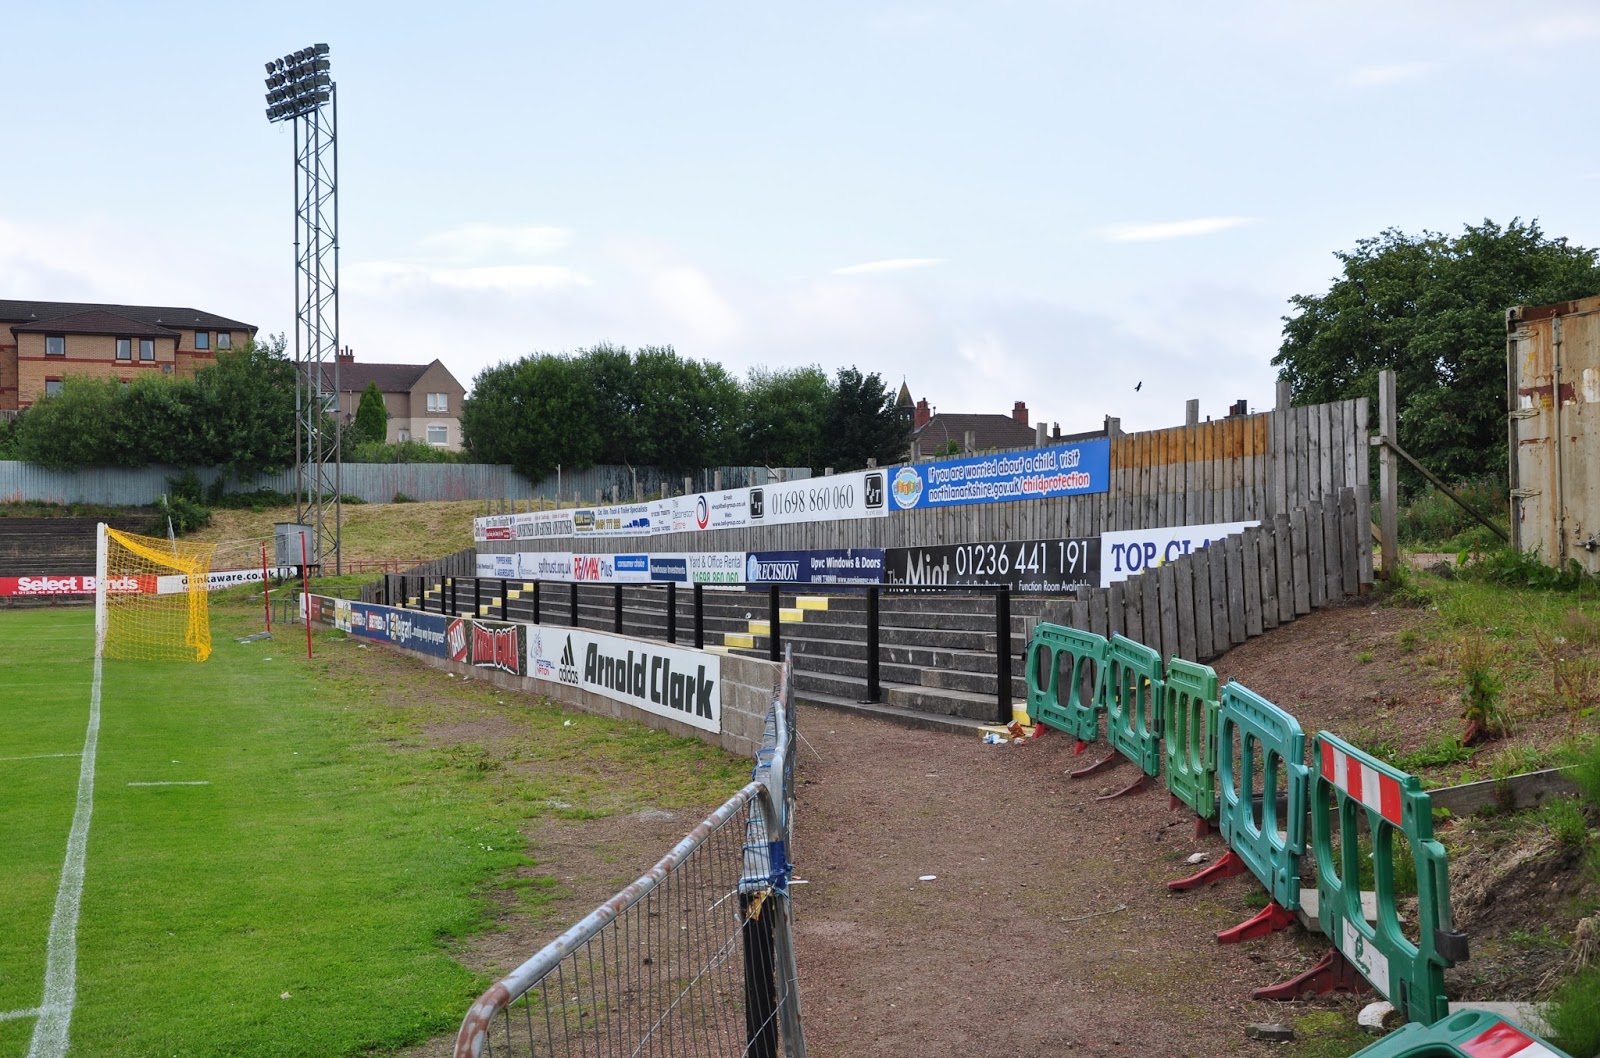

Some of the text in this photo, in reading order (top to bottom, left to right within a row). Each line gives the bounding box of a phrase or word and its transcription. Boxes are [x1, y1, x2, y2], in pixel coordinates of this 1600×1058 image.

[929, 467, 935, 482] If
[936, 467, 949, 484] you
[951, 465, 963, 480] are
[965, 459, 997, 479] worried
[998, 457, 1023, 475] about
[1025, 459, 1032, 472] a
[1033, 451, 1058, 471] child,
[1060, 449, 1080, 468] visit
[772, 484, 853, 515] 01698 860 060
[574, 556, 612, 581] RE/MAX Plus
[689, 555, 742, 569] Yard & Office Rental
[811, 557, 881, 570] Upvc Windows & Doors
[906, 550, 949, 586] Mint
[956, 541, 1088, 575] 01236 441 191
[1111, 541, 1156, 572] TOP
[181, 569, 275, 585] dinkaware.co.uk
[749, 561, 799, 580] PRECISION
[18, 576, 138, 591] Select Bnds
[1019, 580, 1042, 591] Function
[1043, 579, 1060, 591] Room
[495, 624, 519, 675] COLA
[559, 664, 578, 685] adidas
[584, 642, 714, 720] Arnold Clark
